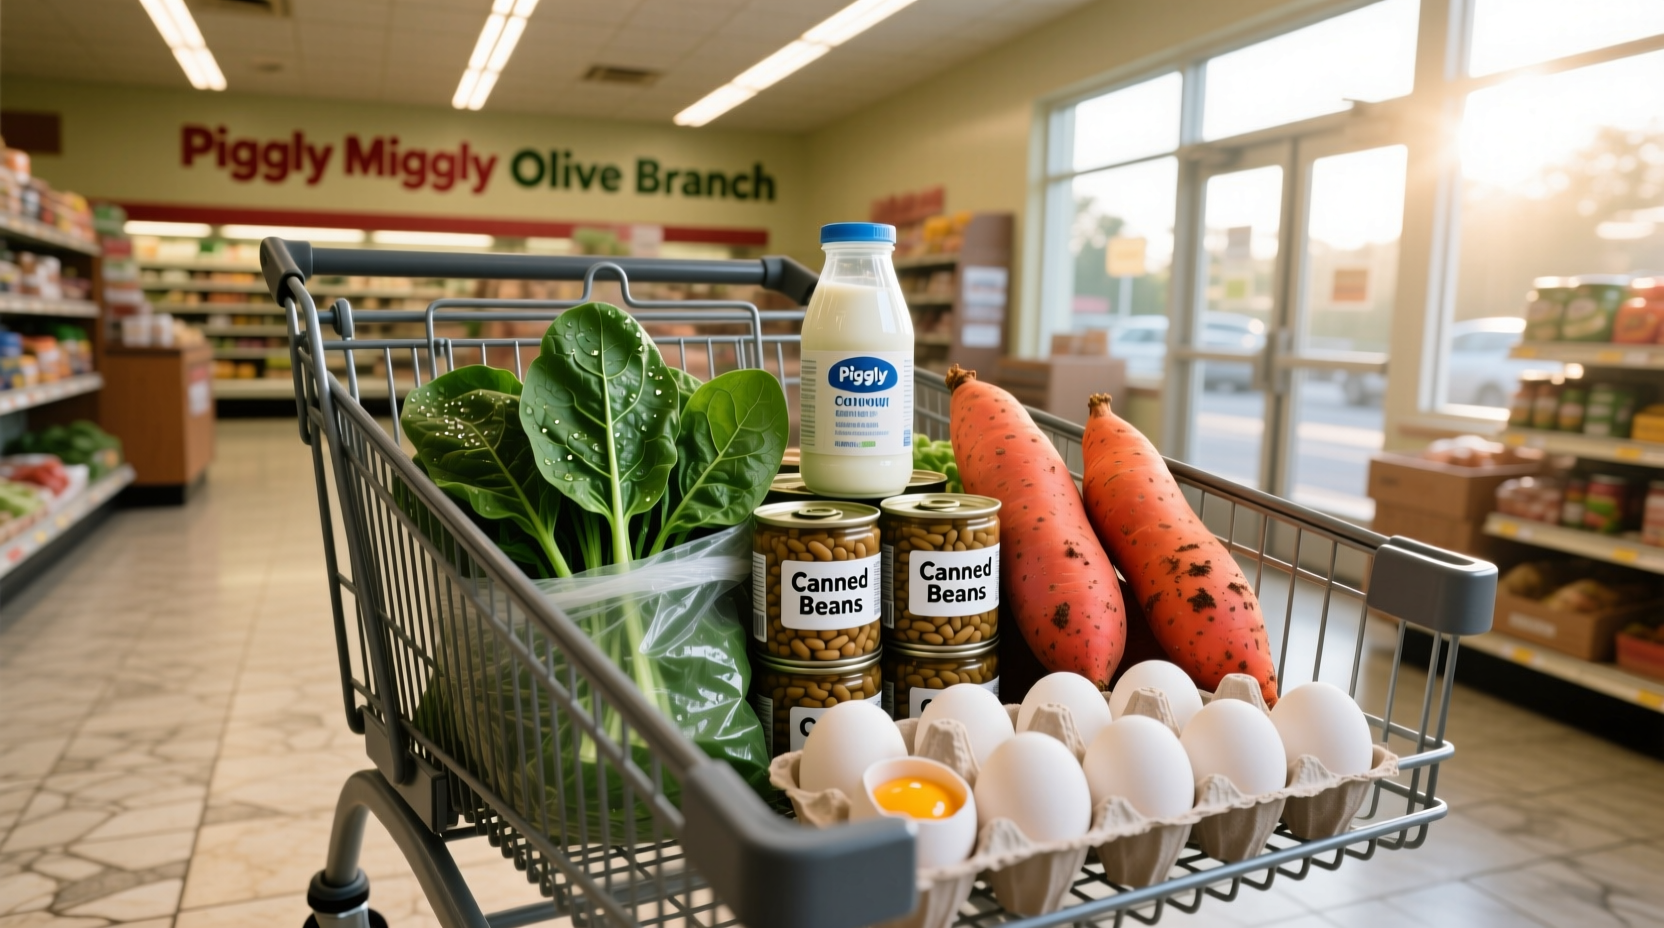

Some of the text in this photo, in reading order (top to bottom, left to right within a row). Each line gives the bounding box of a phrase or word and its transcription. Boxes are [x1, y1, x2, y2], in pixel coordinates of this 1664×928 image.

[181, 125, 776, 201] Piggly Miggly Olive Branch
[839, 365, 888, 386] Piggly
[791, 567, 868, 593] Canned
[919, 556, 992, 581] Canned
[927, 584, 987, 603] Beans
[799, 596, 863, 615] Beans
